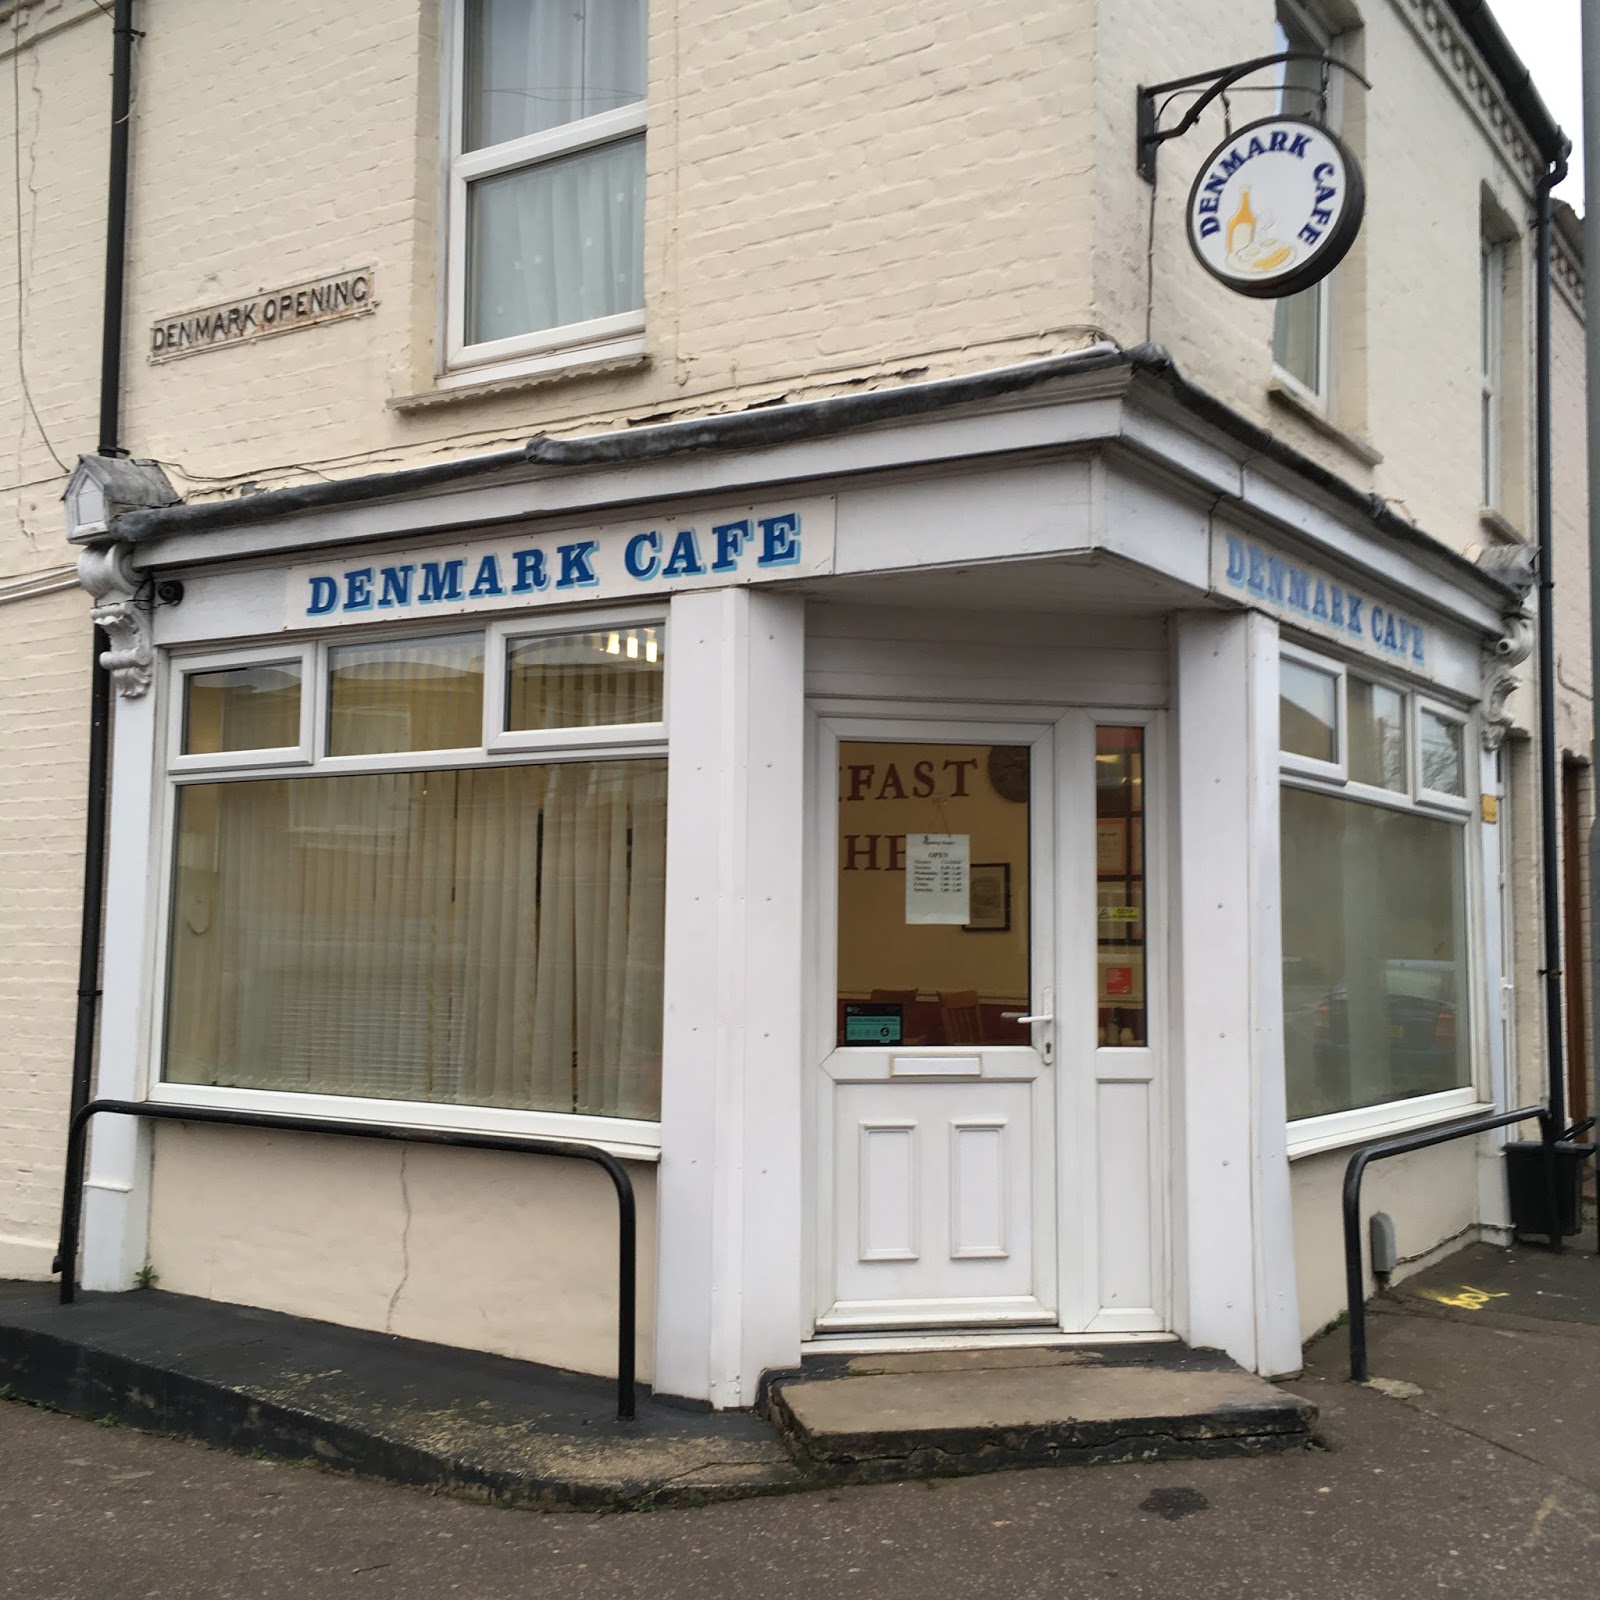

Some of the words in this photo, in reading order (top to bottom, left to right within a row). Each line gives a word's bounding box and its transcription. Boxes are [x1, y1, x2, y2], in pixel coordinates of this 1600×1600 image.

[1199, 131, 1313, 239] DENMARK
[1296, 162, 1337, 246] CAFE
[152, 303, 260, 350] DENMARK
[263, 276, 367, 324] OPENING
[306, 539, 600, 617] DENMARK
[624, 513, 803, 581] CAFE
[1226, 534, 1363, 641] DENMARK
[1371, 604, 1425, 668] CAFE
[839, 759, 978, 801] FAST
